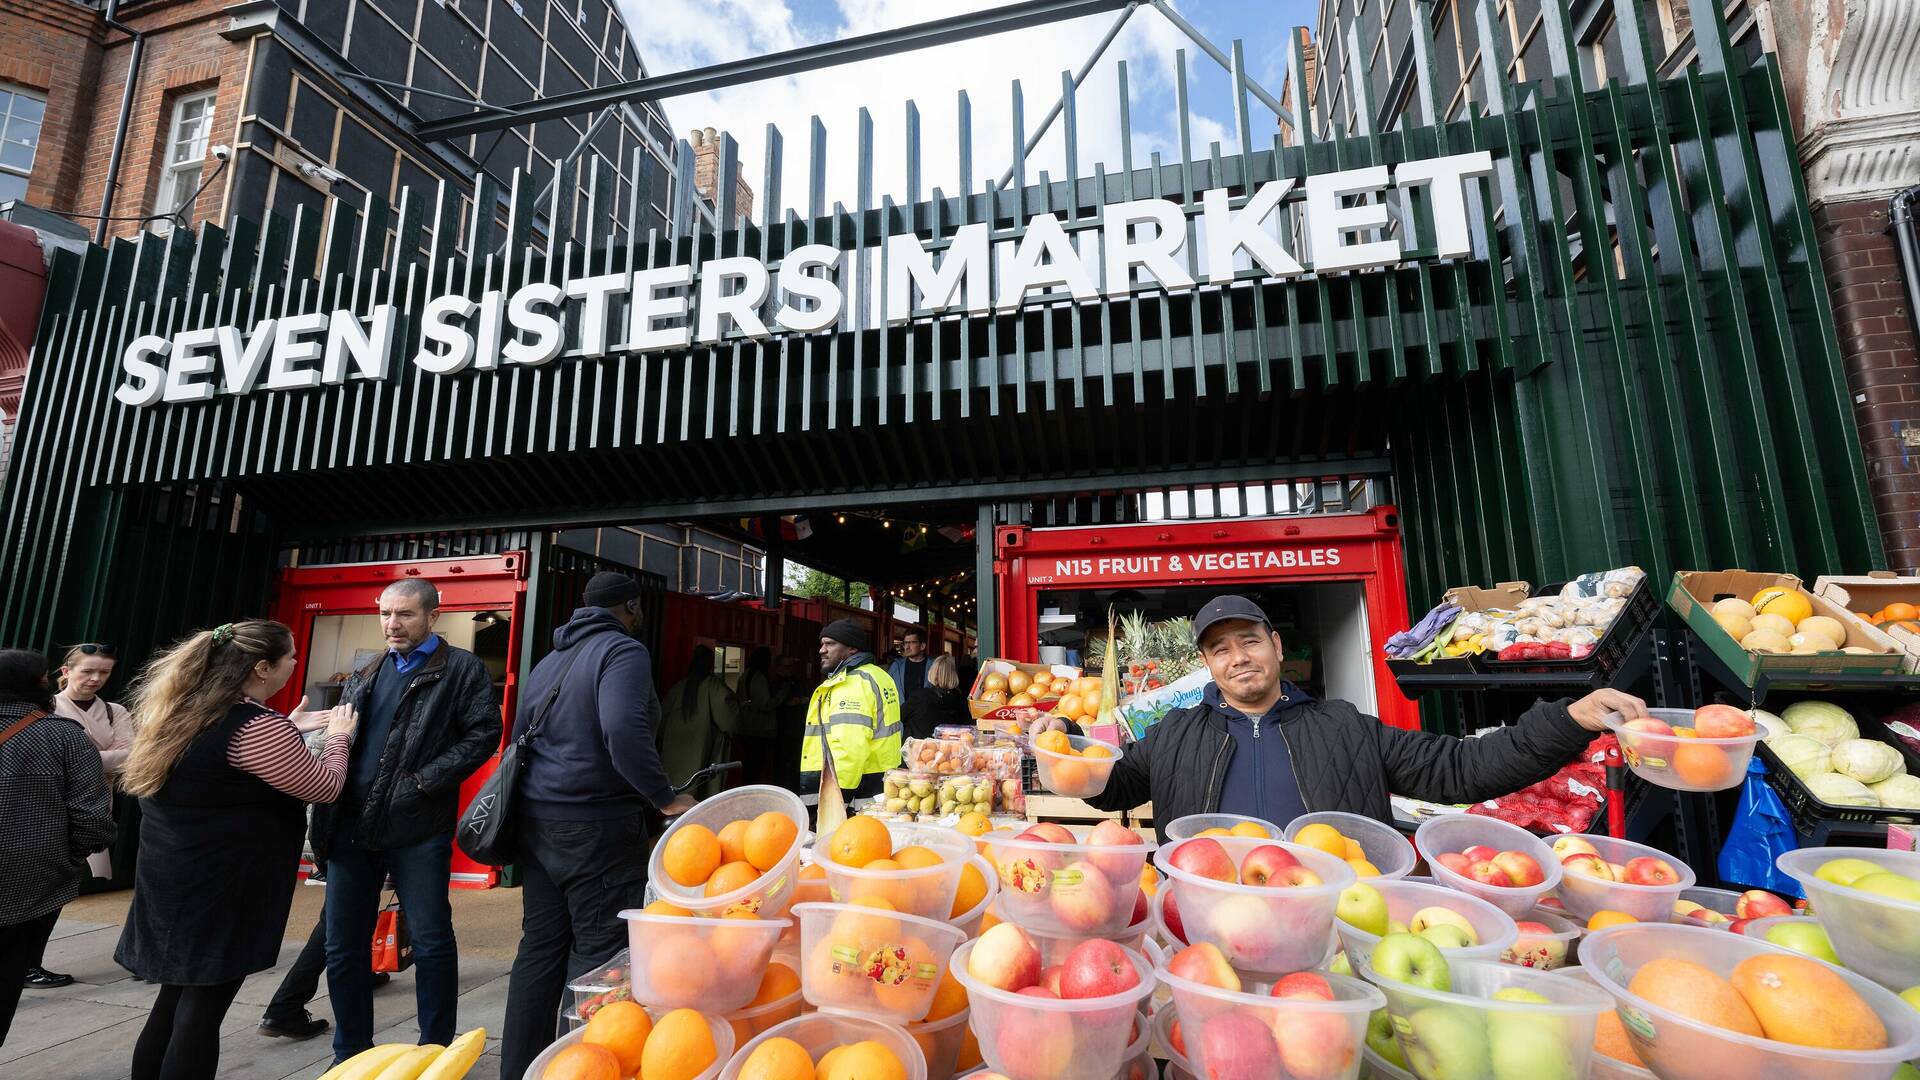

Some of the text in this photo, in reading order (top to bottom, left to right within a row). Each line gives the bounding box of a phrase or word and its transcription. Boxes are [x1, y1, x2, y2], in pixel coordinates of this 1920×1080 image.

[115, 151, 1493, 408] SEVEN SISTERS MARKET
[1056, 548, 1341, 577] N15 FRUIT & VEGETABLES
[1171, 687, 1202, 708] Young
